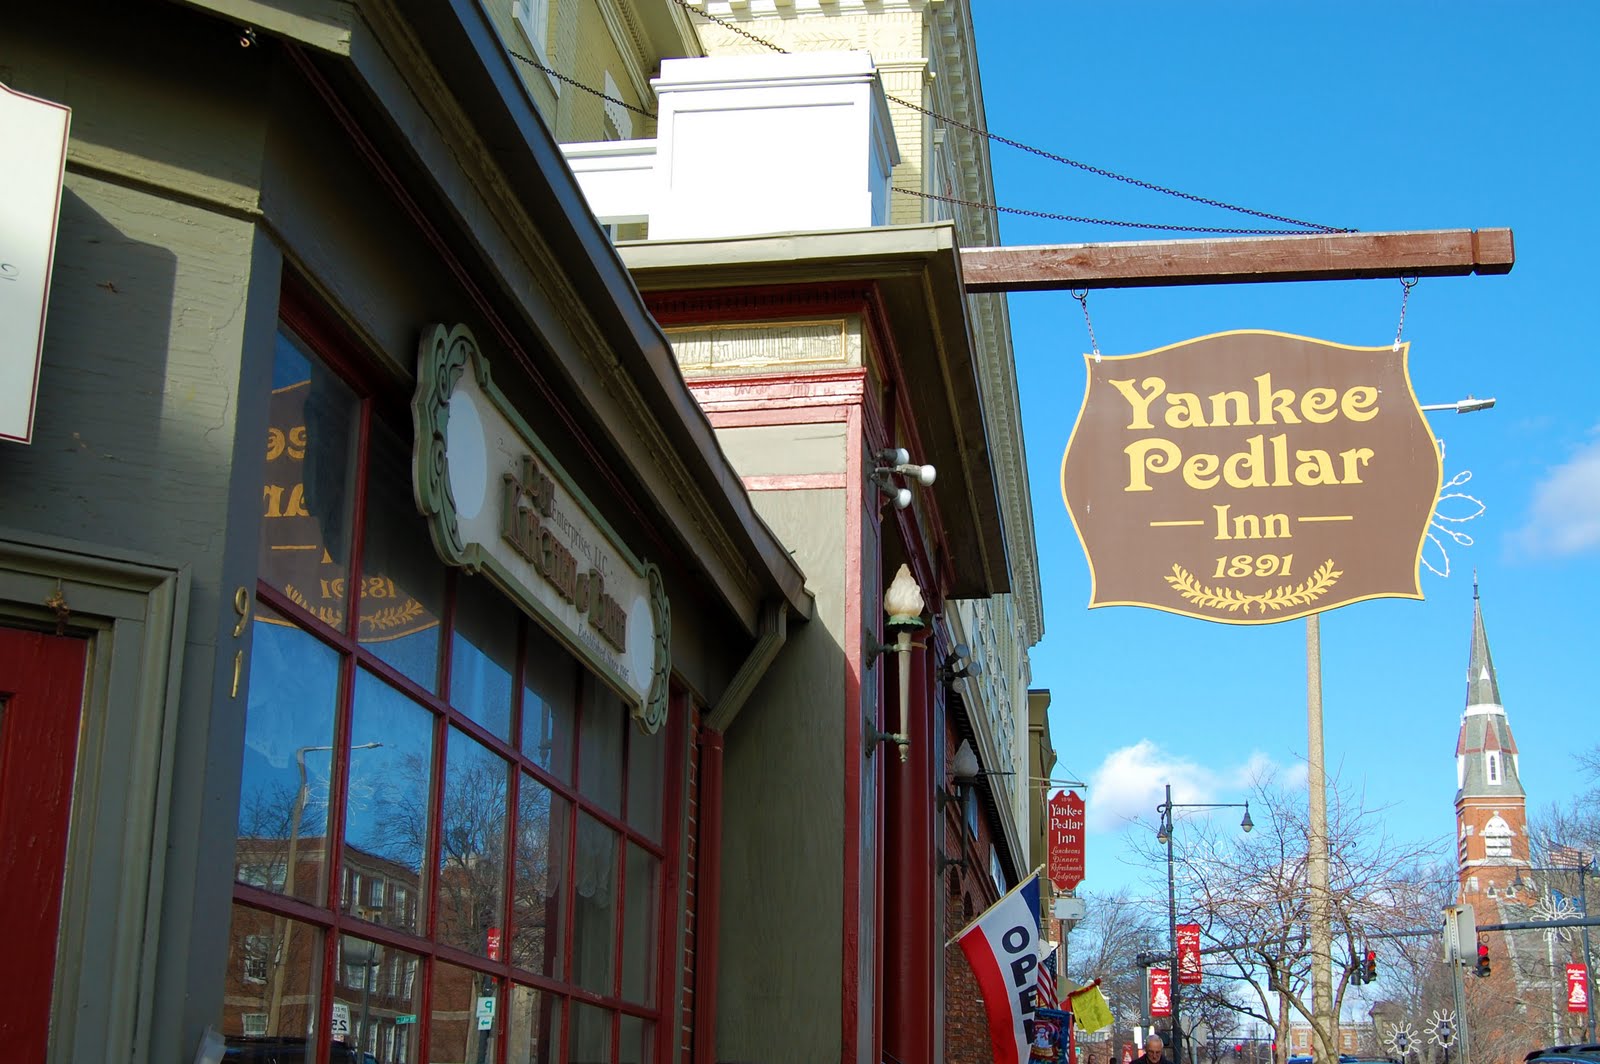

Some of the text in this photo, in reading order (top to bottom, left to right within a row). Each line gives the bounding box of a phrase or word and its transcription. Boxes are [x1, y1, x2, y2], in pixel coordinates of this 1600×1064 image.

[1108, 372, 1380, 430] Yankee
[1123, 433, 1375, 492] Pedlar
[1212, 504, 1293, 540] Inn
[1212, 553, 1294, 578] 1891
[1051, 804, 1083, 817] Yankee
[1051, 818, 1083, 831] Pedlar
[1057, 831, 1076, 845] Inn
[1053, 871, 1081, 881] Lodgings
